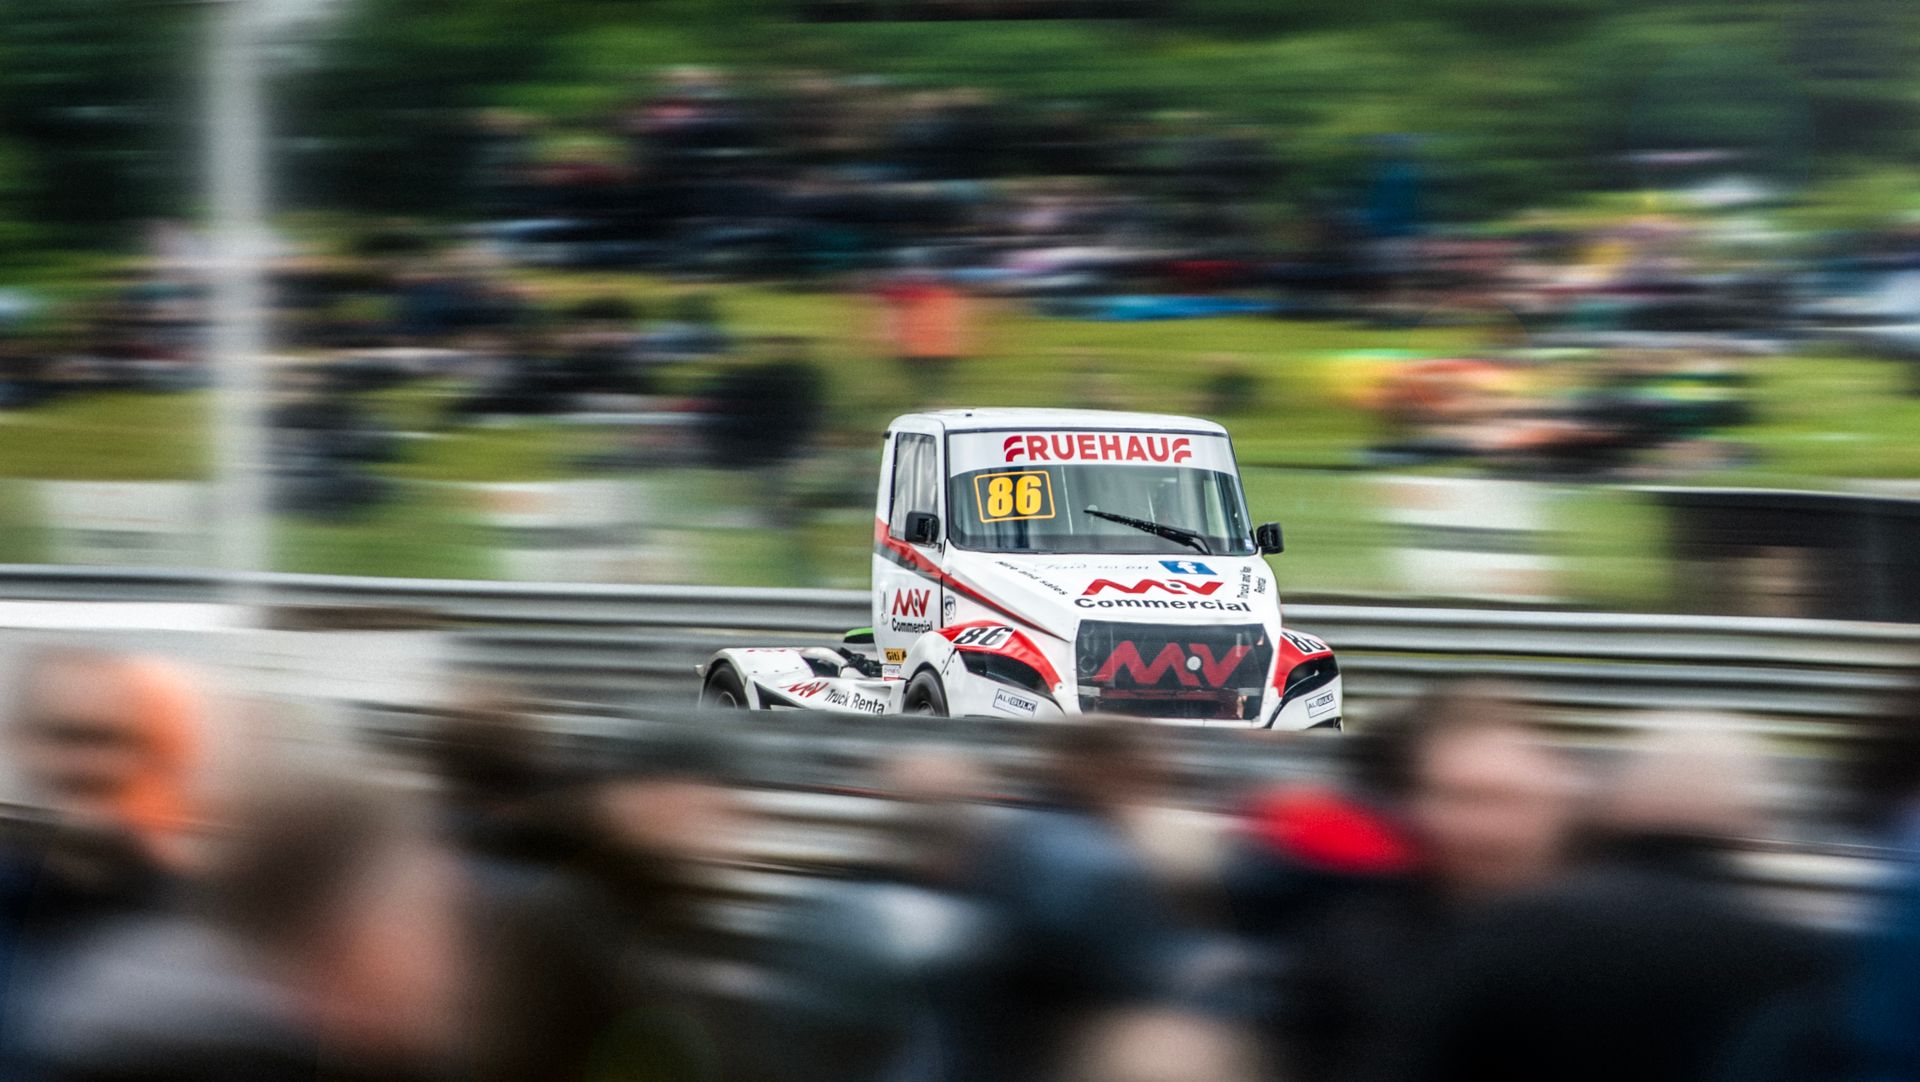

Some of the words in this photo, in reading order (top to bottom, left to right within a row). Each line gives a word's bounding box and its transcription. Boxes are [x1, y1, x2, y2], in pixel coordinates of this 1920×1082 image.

[1003, 434, 1192, 463] FRUEHAUF
[987, 475, 1042, 517] 86
[1074, 598, 1252, 613] Commercial
[892, 618, 933, 633] Commercial
[953, 627, 1014, 646] 86
[1282, 632, 1326, 652] 86
[886, 651, 900, 661] Giti
[824, 688, 850, 707] Truck
